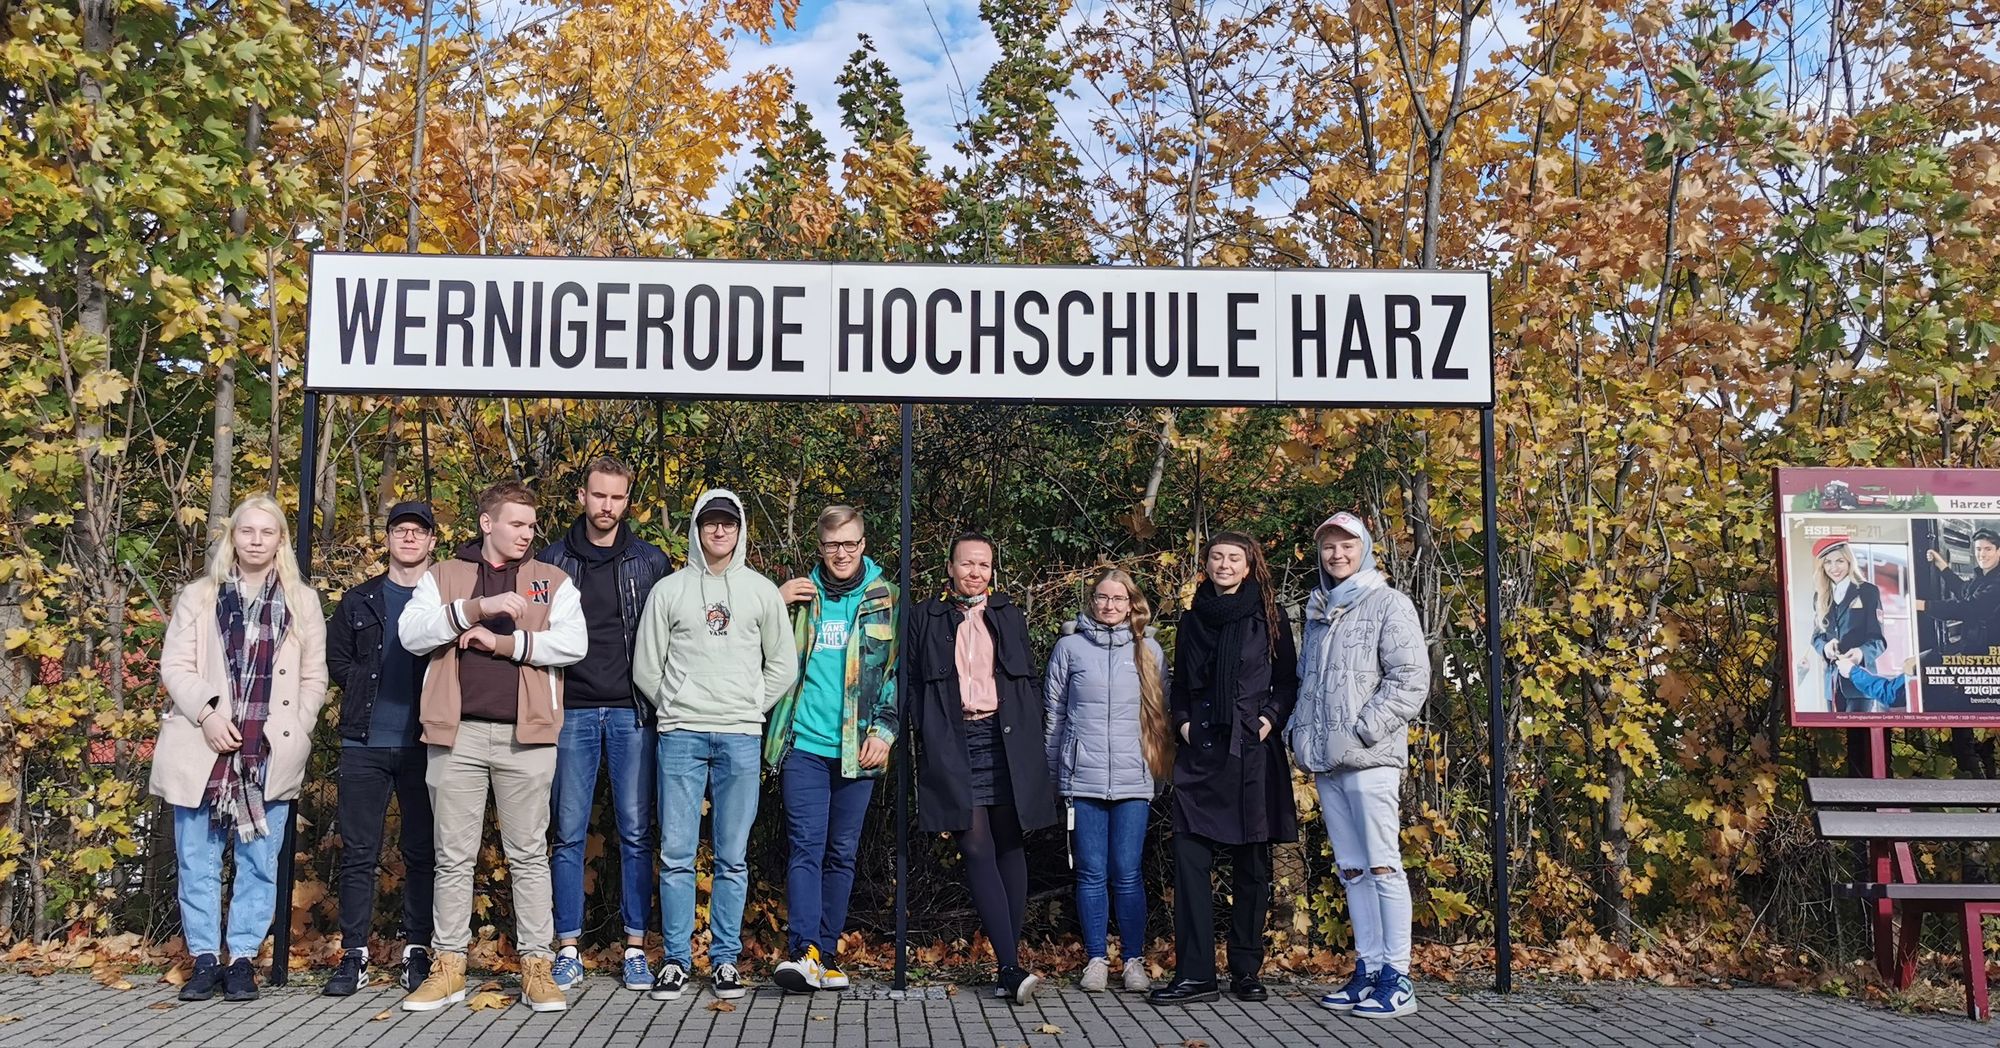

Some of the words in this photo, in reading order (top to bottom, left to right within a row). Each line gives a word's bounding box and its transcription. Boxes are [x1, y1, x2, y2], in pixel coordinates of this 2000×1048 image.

[335, 277, 806, 373] WERNIGERODE
[838, 287, 1260, 378] HOCHSCHULE
[1291, 293, 1469, 380] HARZ
[1950, 499, 1993, 509] Harzer
[1804, 525, 1831, 535] HSB
[531, 580, 550, 604] N
[821, 622, 846, 633] VANS
[823, 631, 841, 646] THE
[1925, 666, 1948, 675] MIT
[1928, 676, 1956, 685] EINE
